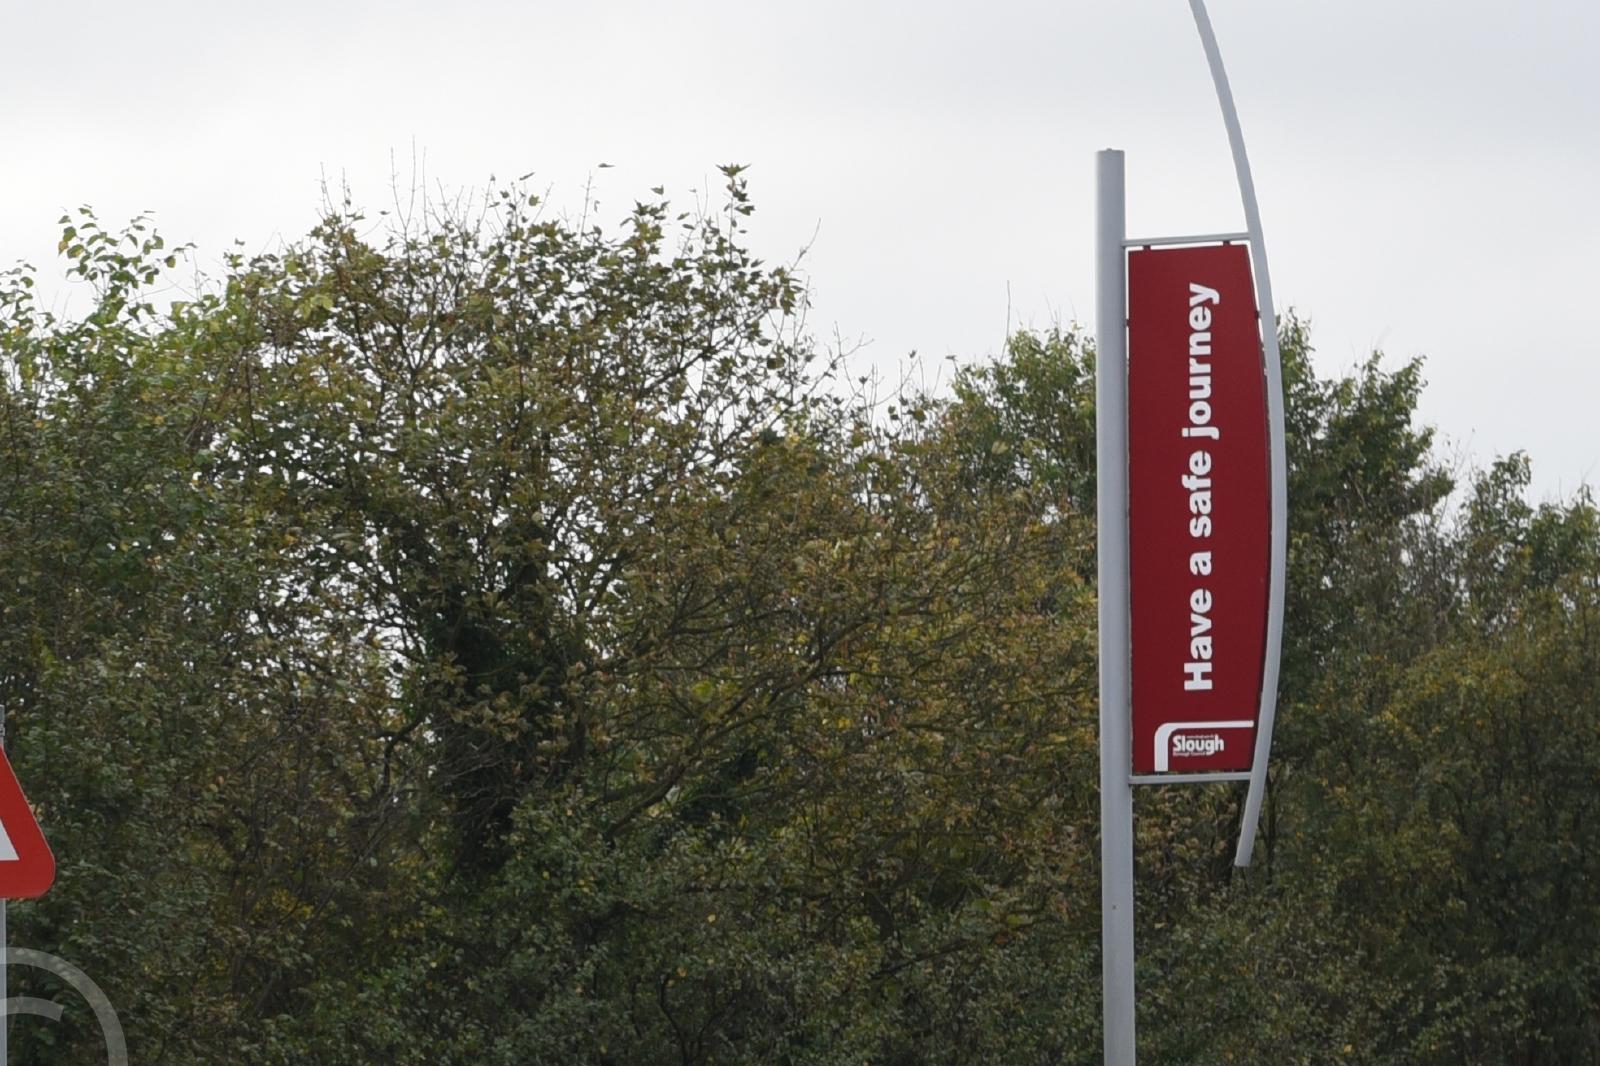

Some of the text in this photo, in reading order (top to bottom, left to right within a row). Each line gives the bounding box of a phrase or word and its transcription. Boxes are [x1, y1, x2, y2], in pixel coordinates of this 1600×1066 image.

[1181, 282, 1221, 691] Have a safe journey
[1172, 732, 1225, 756] Slough
